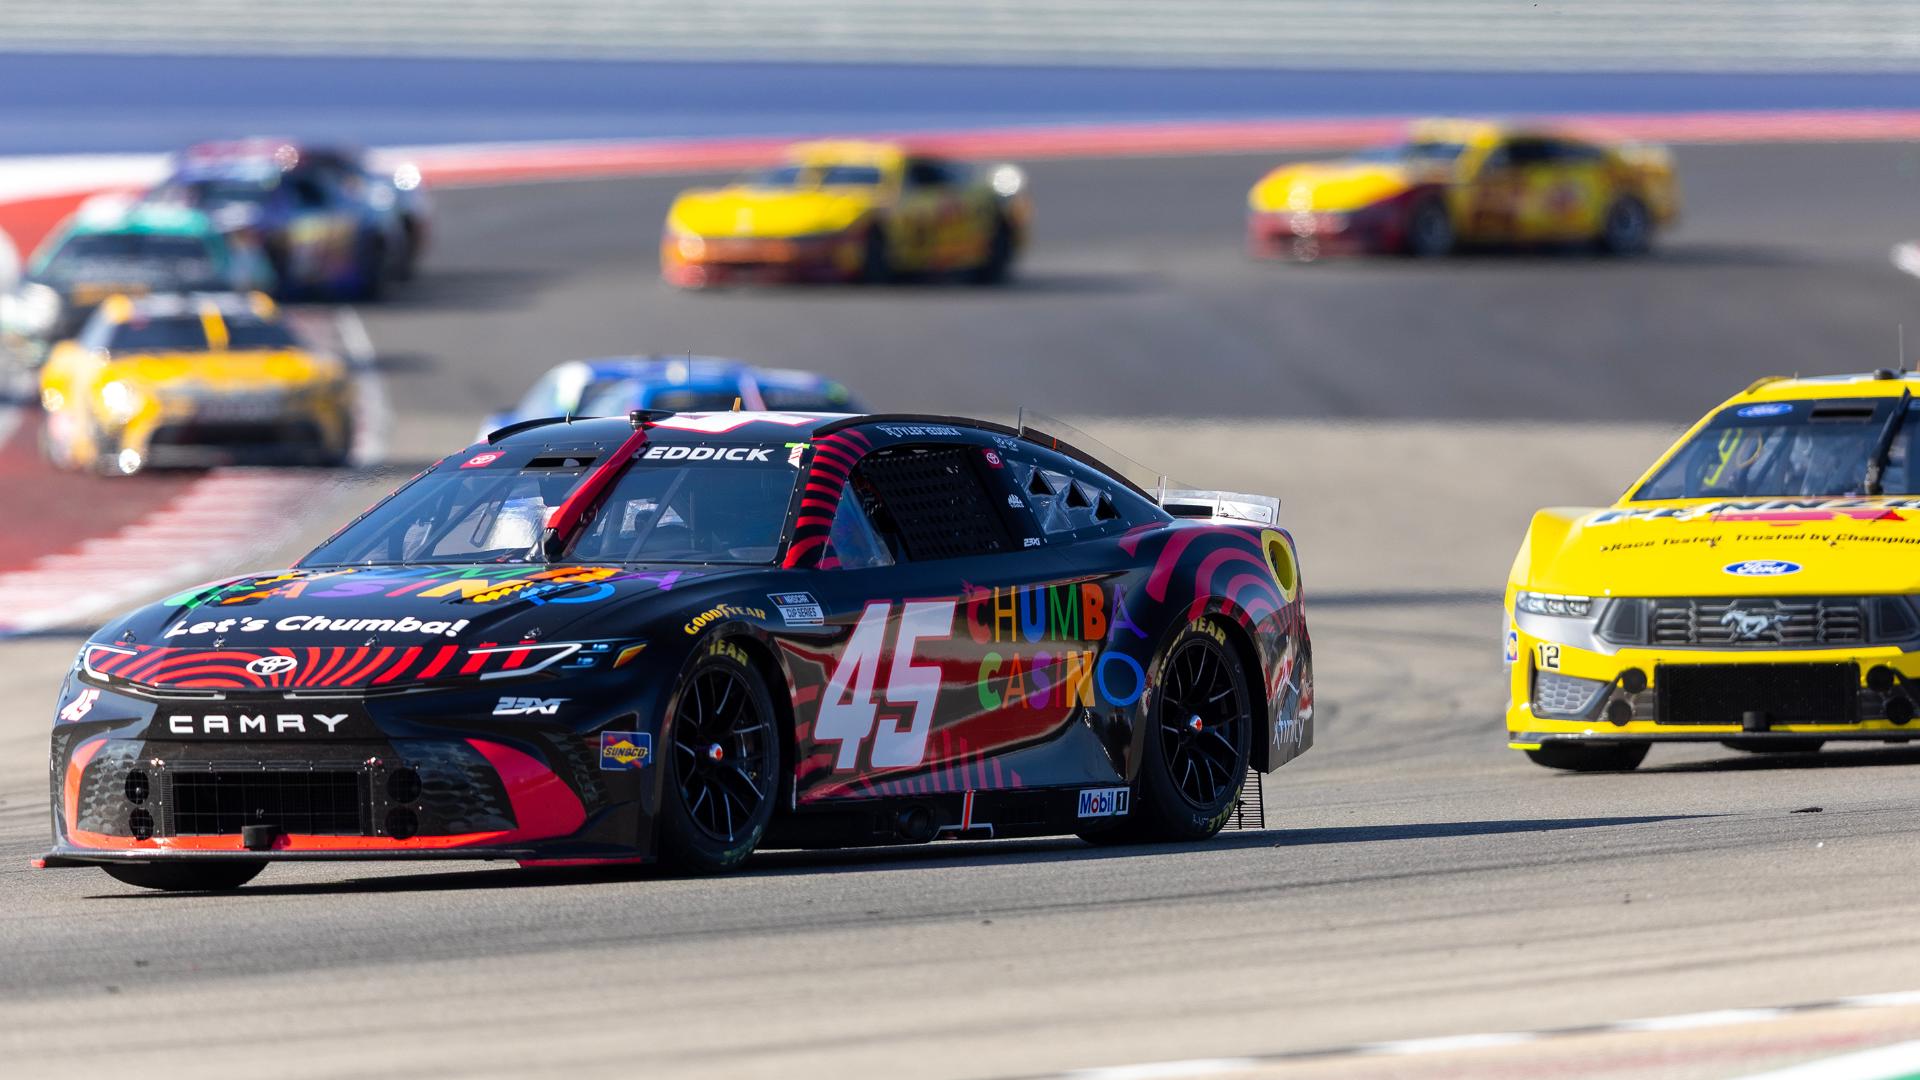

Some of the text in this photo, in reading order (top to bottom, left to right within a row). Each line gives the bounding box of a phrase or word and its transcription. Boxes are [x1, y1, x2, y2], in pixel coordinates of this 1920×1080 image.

[1736, 560, 1788, 575] Ford
[683, 603, 767, 636] GOODYEAR
[966, 582, 1149, 645] CHUMBA
[164, 615, 471, 639] Let's Chumba!
[1538, 645, 1560, 669] 12
[812, 598, 958, 772] 45
[978, 651, 1146, 711] CASINO
[60, 688, 101, 722] 45
[169, 713, 349, 734] CAMRY
[603, 746, 648, 759] SUNOCO
[1079, 791, 1115, 814] Mobil
